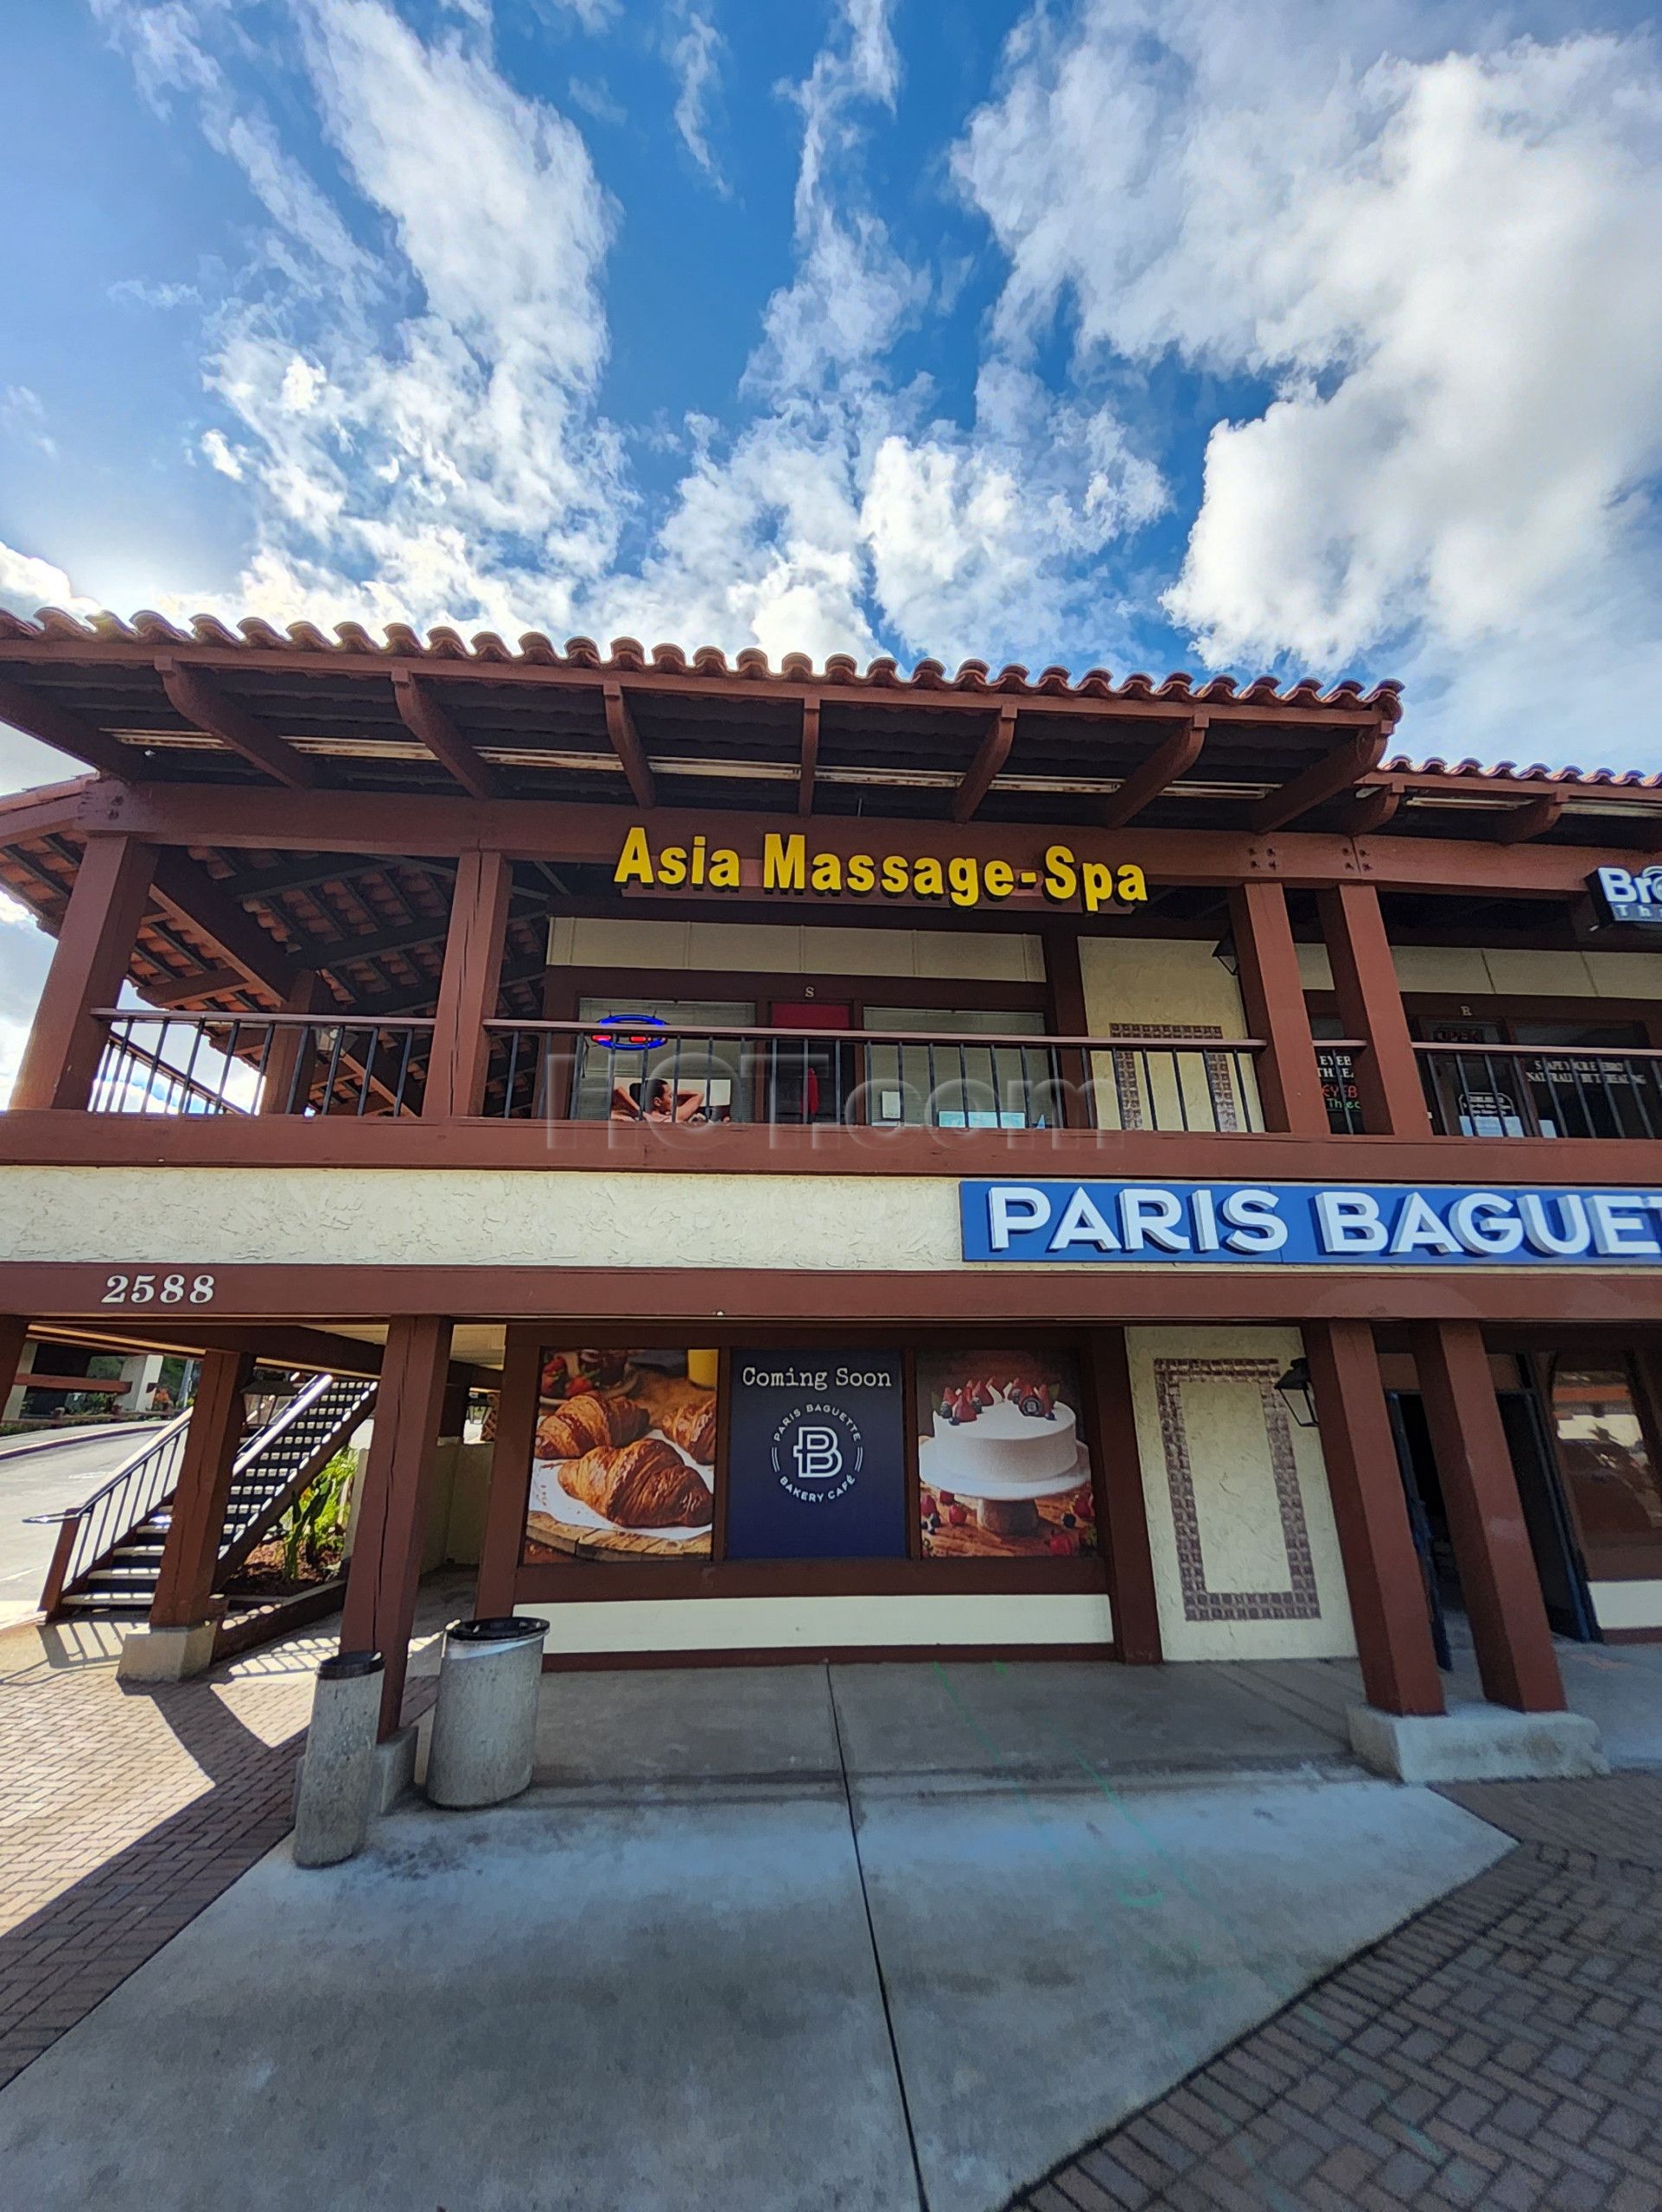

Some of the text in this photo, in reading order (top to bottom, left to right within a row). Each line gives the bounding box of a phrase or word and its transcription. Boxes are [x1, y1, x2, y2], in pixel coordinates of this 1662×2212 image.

[614, 827, 1149, 912] Asia Massage-Spa
[805, 986, 815, 998] S
[989, 1186, 1662, 1257] PARIS BAGUE
[100, 1274, 215, 1304] 2588
[742, 1366, 892, 1391] Coming Soon
[774, 1403, 861, 1442] PARIS BAGUETTE
[780, 1476, 824, 1503] BAKERY
